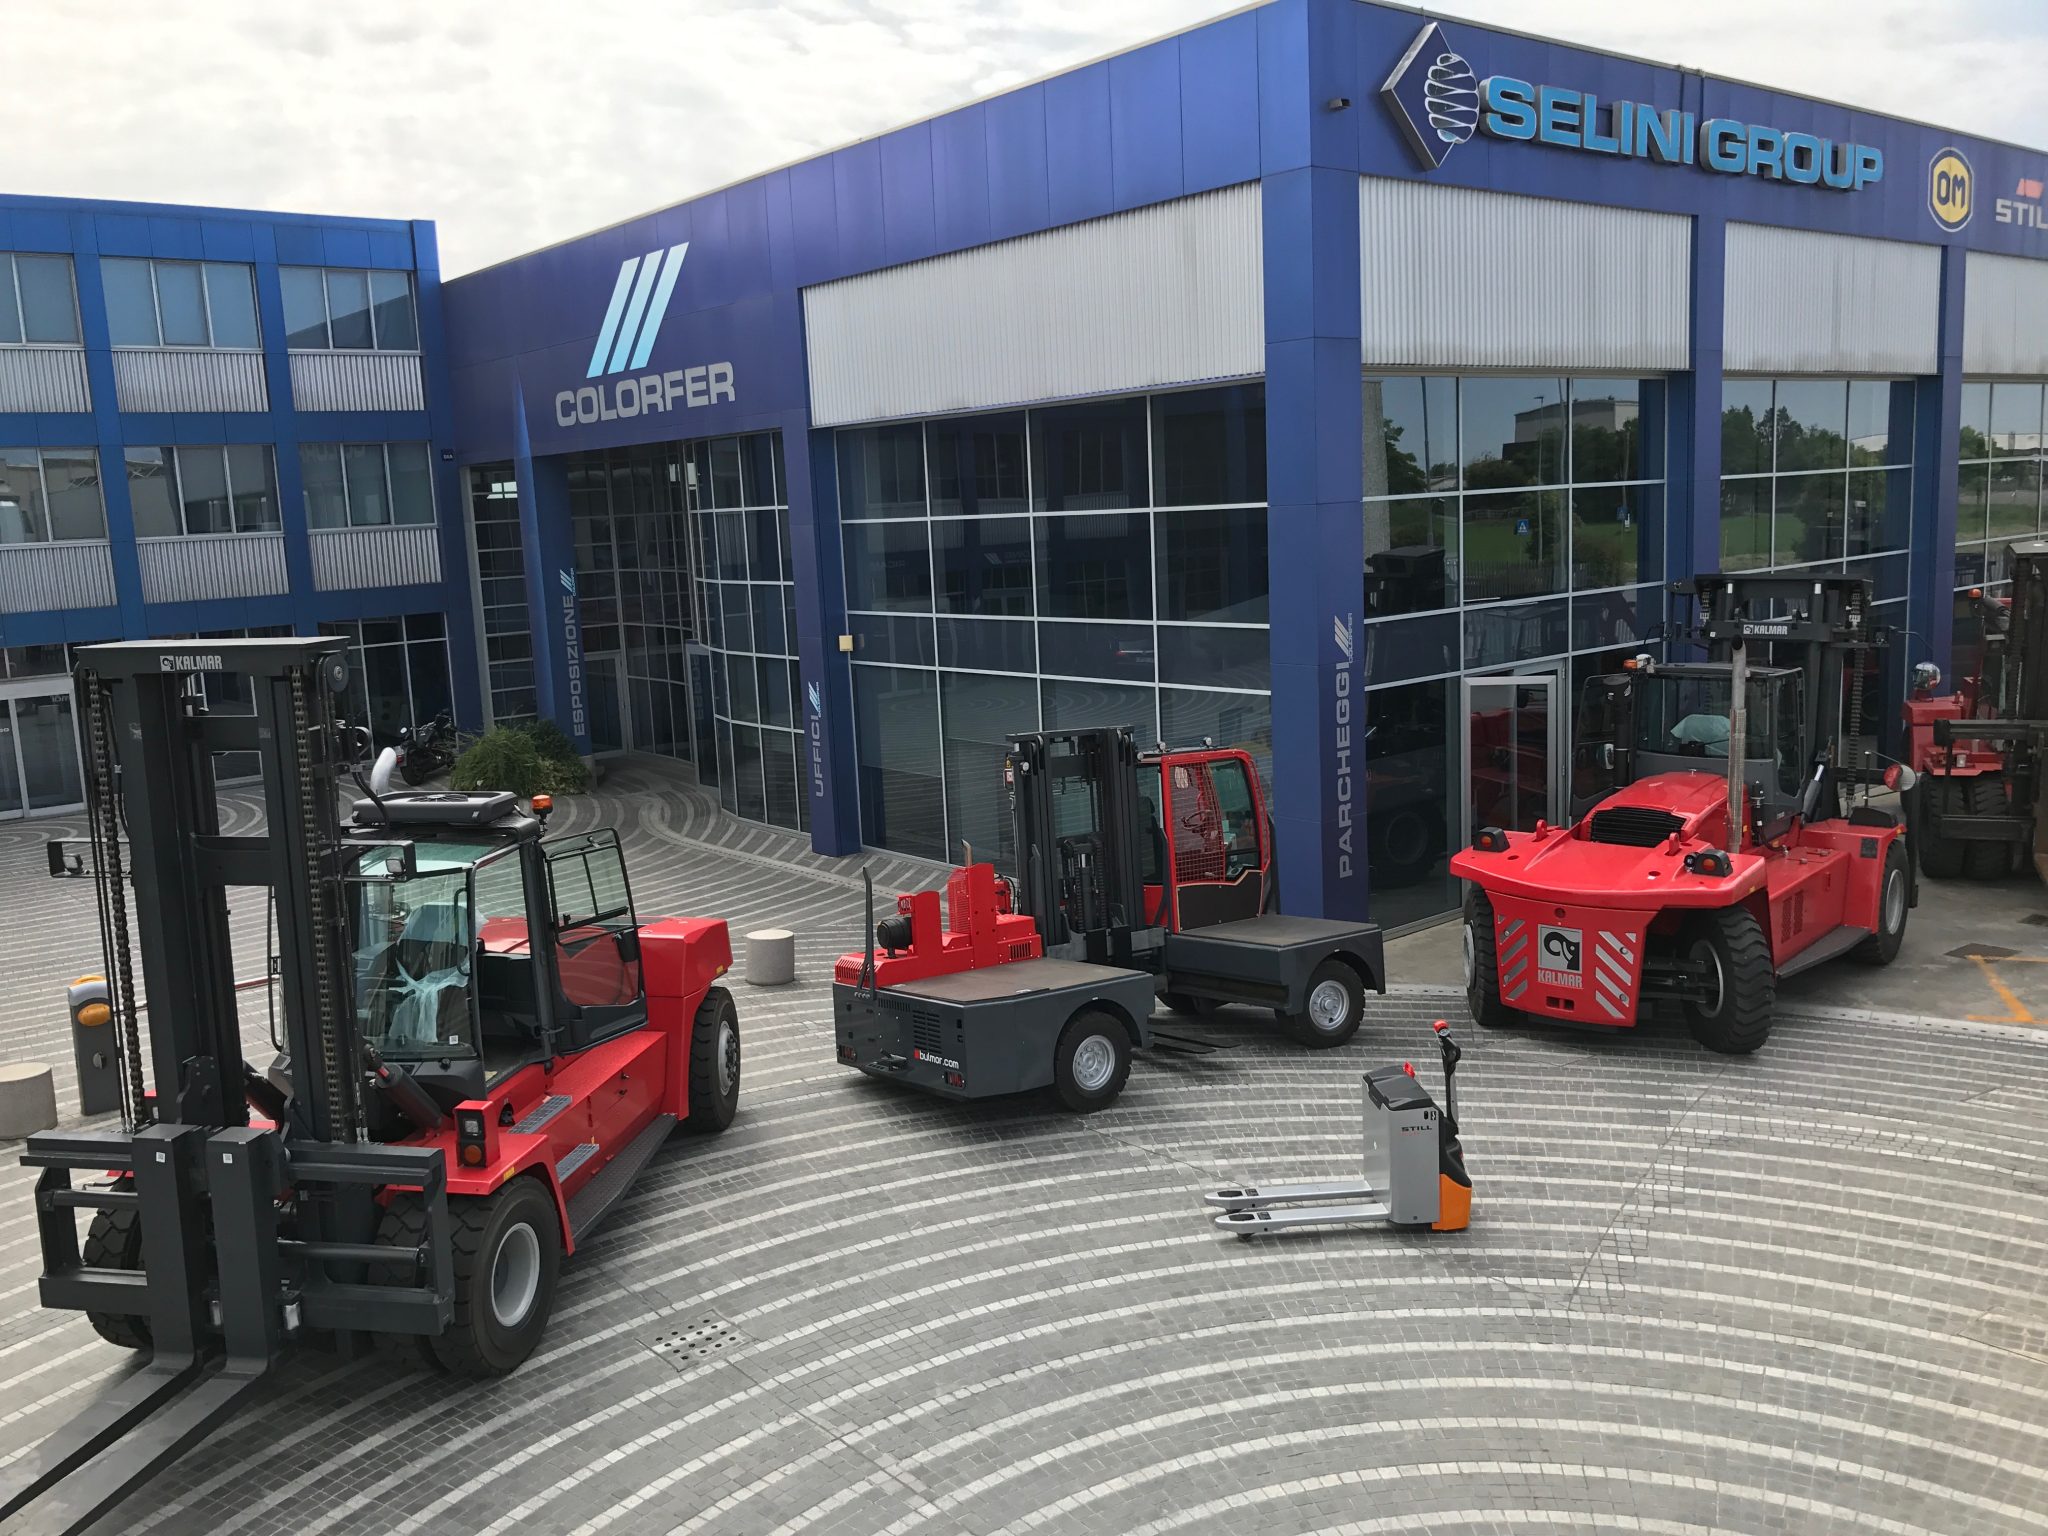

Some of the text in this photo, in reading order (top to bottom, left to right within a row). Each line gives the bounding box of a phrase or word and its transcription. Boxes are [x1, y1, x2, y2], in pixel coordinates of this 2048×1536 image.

[1479, 75, 1883, 191] SELINI GROUP
[1936, 170, 1966, 210] OM
[555, 361, 736, 427] COLORFER
[1754, 625, 1788, 635] KALMAR
[175, 655, 223, 671] KALMAR
[563, 595, 586, 737] ESPOSIZIONE
[811, 714, 824, 797] UFFICI
[1335, 661, 1353, 879] PARCHEGGI
[1538, 969, 1583, 988] KALMAR
[920, 1050, 959, 1069] bulmar.com
